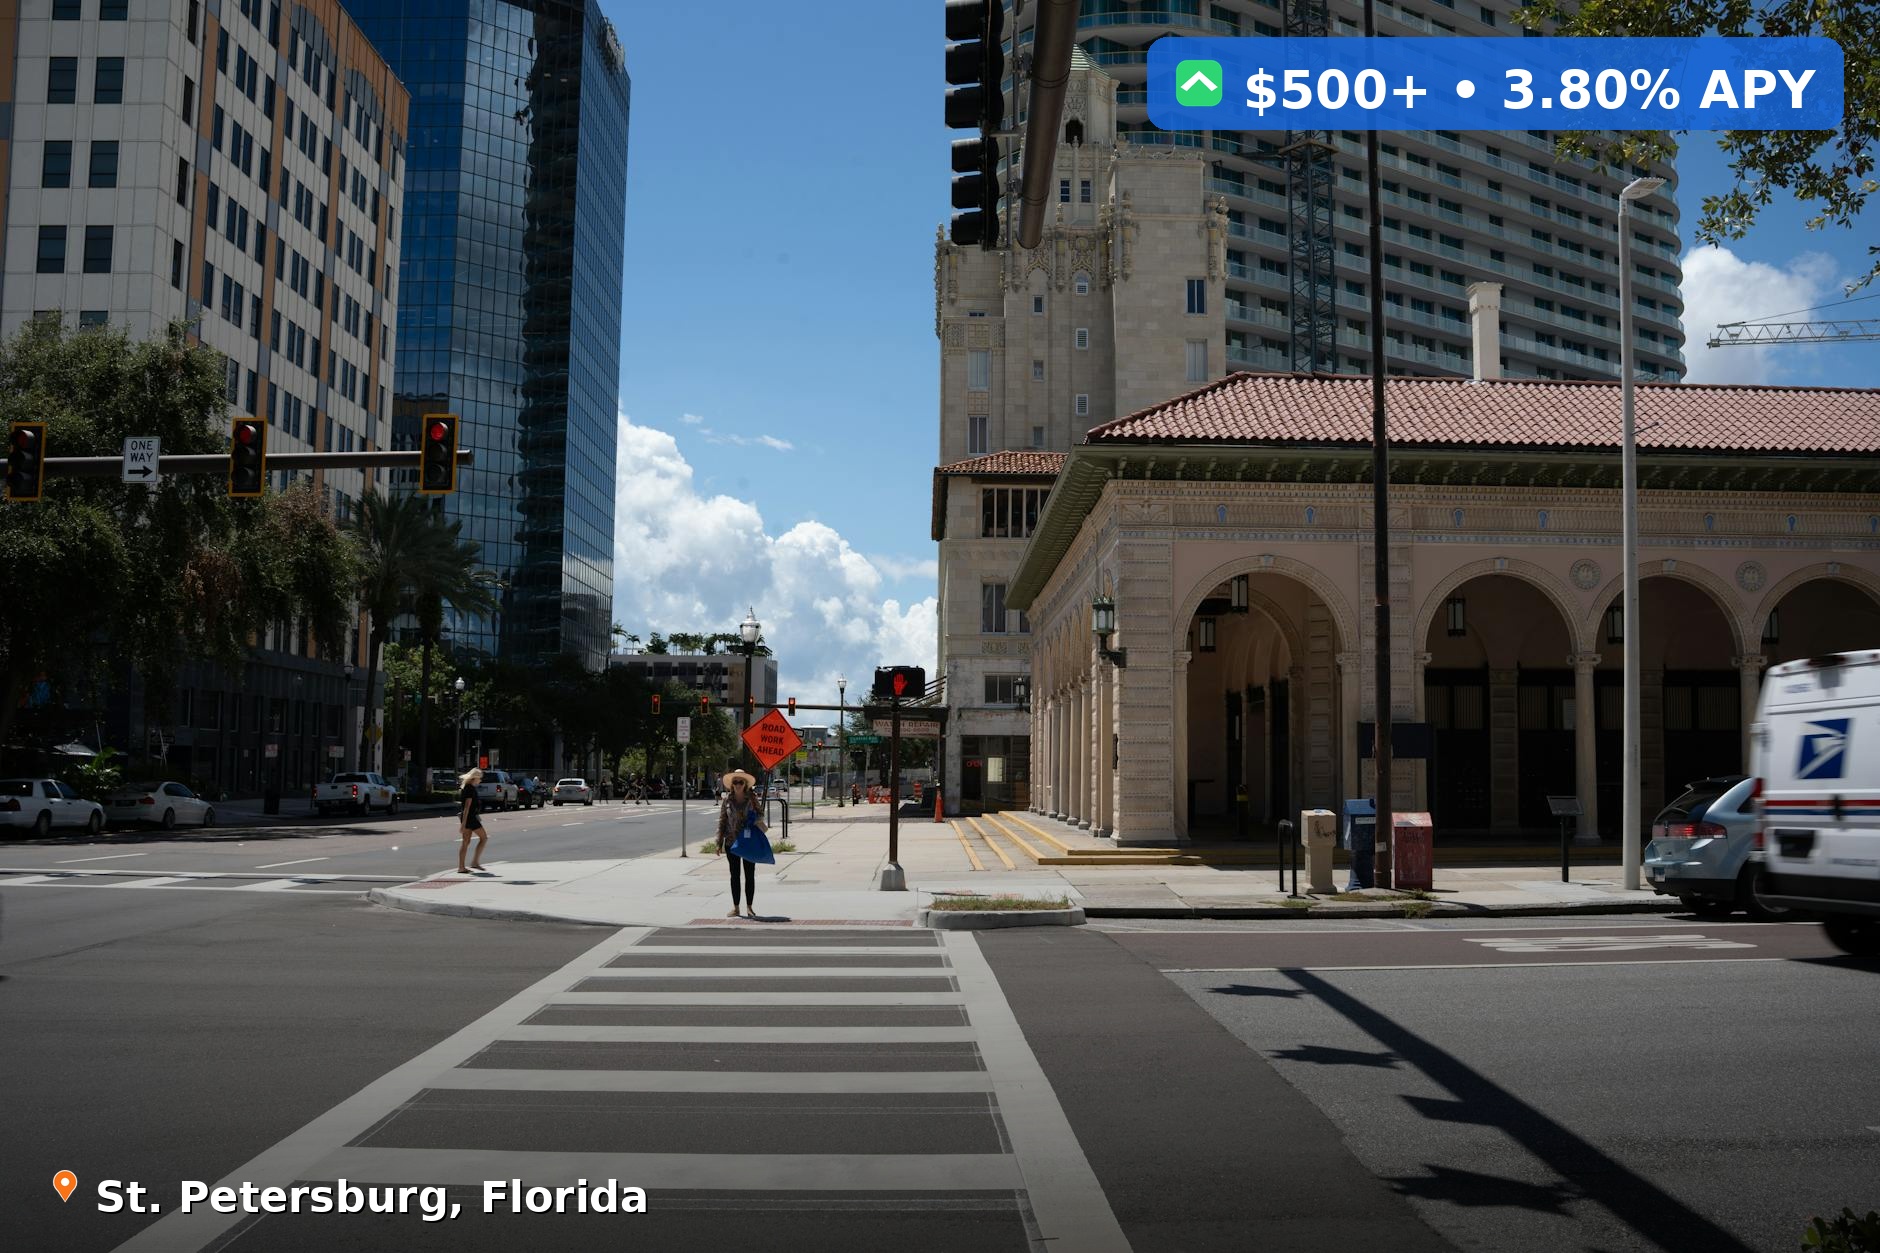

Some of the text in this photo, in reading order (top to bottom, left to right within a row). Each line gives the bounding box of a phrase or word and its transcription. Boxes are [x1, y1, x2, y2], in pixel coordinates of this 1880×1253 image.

[131, 440, 153, 450] ONE
[130, 452, 153, 462] WAY
[762, 723, 786, 733] ROAD
[760, 734, 784, 744] WORK
[757, 745, 784, 756] AHEAD
